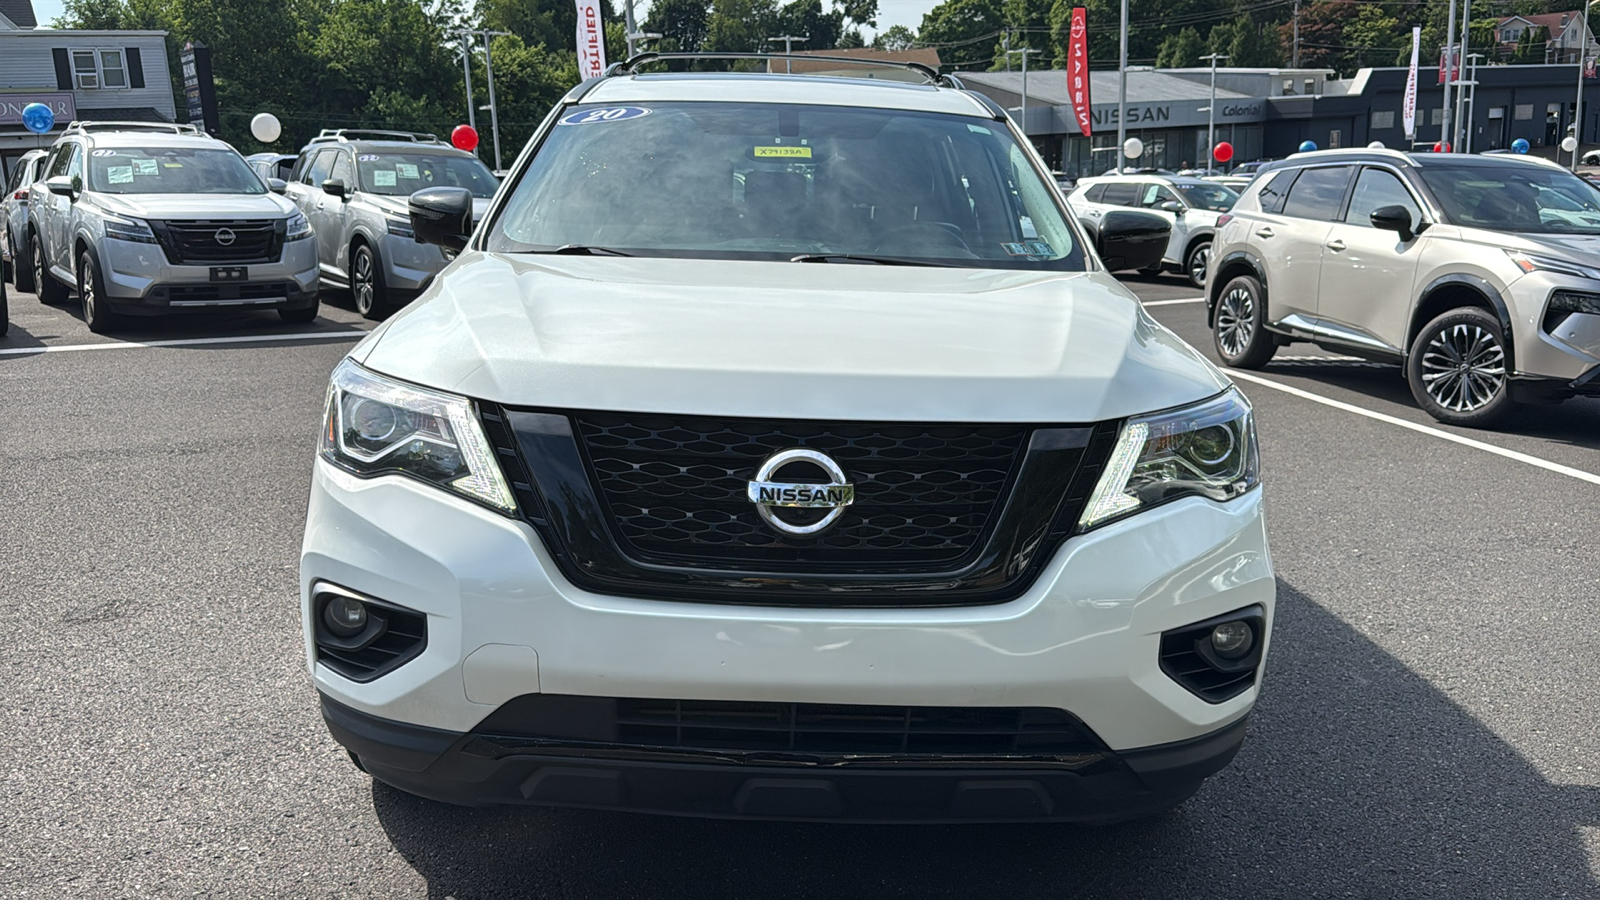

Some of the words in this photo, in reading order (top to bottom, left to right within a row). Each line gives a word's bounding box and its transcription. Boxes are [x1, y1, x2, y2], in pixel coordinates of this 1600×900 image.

[580, 108, 628, 123] 20
[1222, 104, 1261, 117] Colonial
[759, 486, 843, 502] NISSAN
